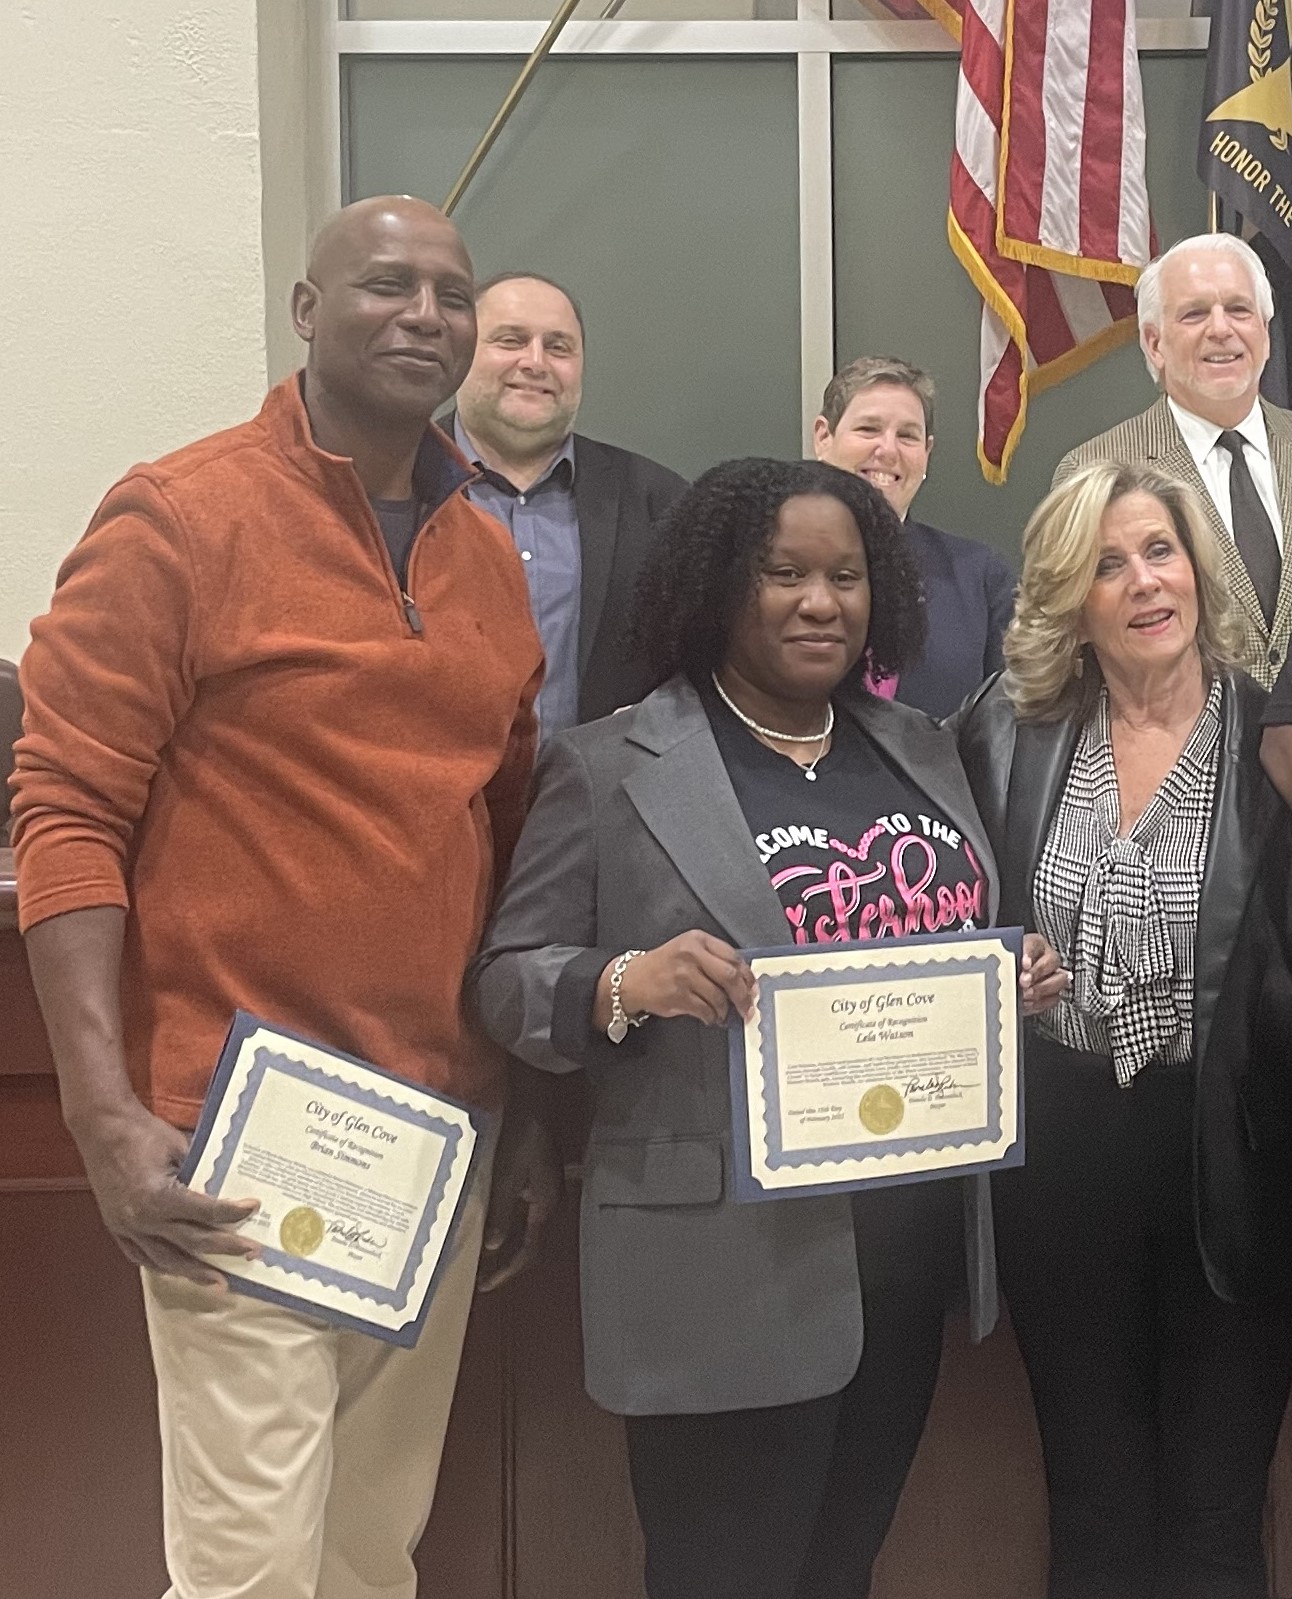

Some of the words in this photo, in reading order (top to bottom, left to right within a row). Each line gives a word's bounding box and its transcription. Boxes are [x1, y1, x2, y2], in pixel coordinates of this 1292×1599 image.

[1209, 130, 1271, 193] HONOR
[755, 825, 830, 864] COME
[876, 812, 912, 836] TO
[917, 814, 962, 850] THE
[831, 999, 857, 1015] City
[859, 994, 875, 1014] of
[876, 993, 903, 1013] Glen
[906, 992, 935, 1006] Cove
[877, 1018, 886, 1029] of
[878, 1029, 914, 1042] Watson
[305, 1100, 331, 1122] City
[331, 1110, 348, 1126] of
[345, 1115, 370, 1134] Glen
[371, 1125, 398, 1144] Cove
[310, 1140, 334, 1156] Brian
[333, 1149, 371, 1170] Simmons
